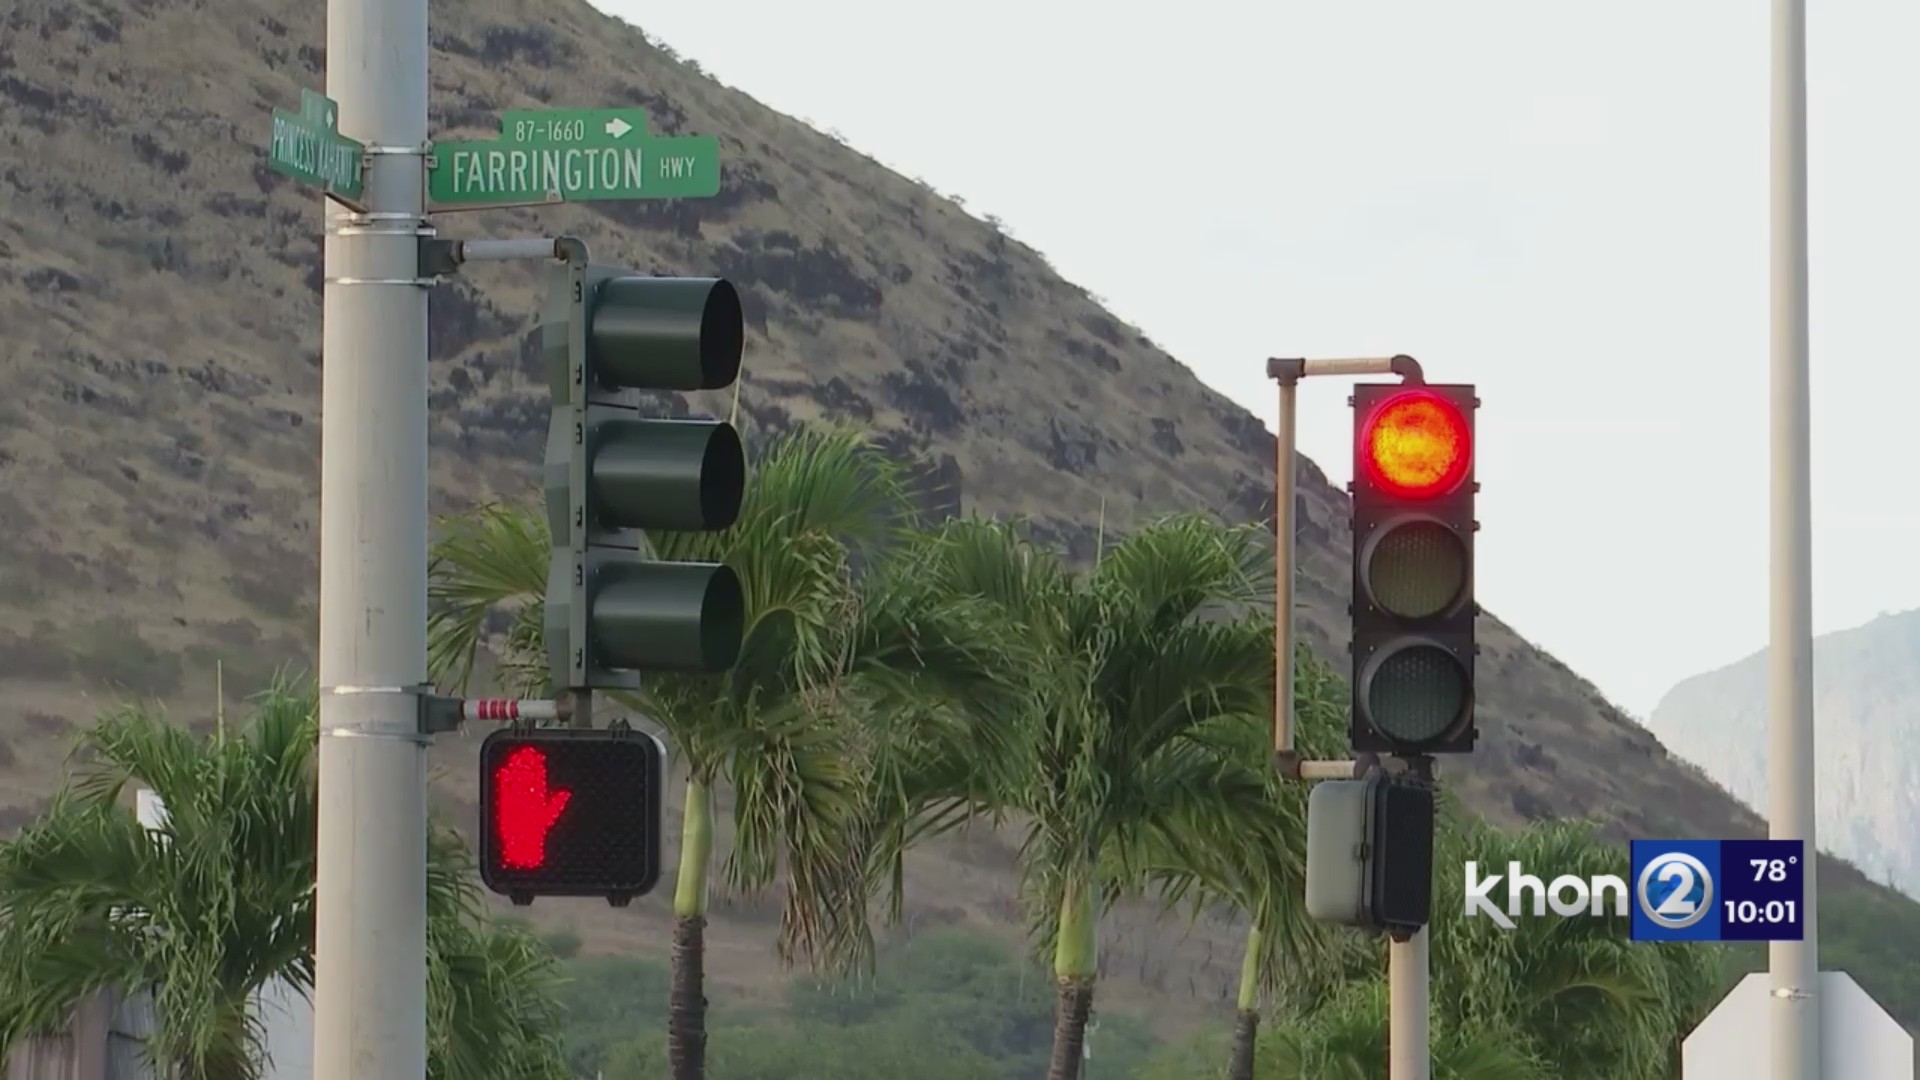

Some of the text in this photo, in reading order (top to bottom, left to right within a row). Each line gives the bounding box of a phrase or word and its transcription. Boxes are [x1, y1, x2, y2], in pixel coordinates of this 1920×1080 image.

[516, 120, 584, 142] 87-1660
[453, 148, 696, 193] FARRINGTON HWY
